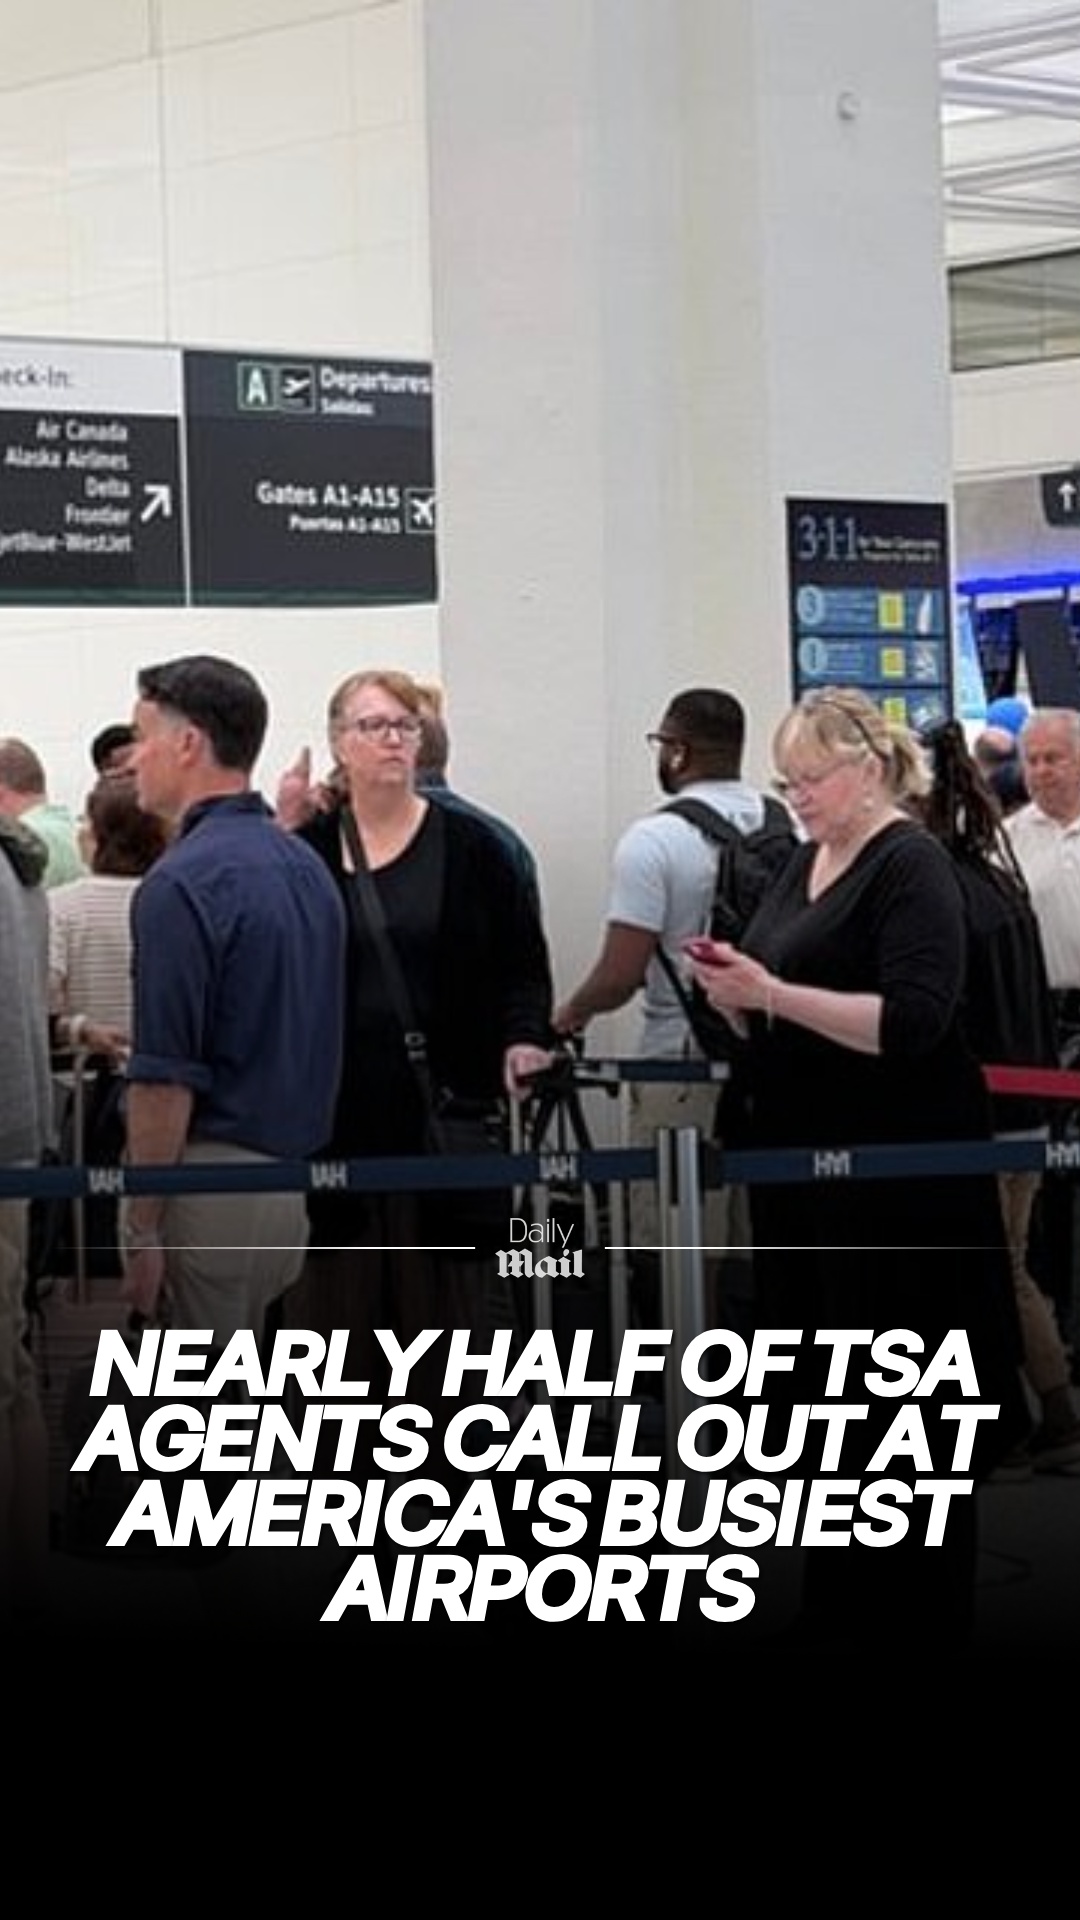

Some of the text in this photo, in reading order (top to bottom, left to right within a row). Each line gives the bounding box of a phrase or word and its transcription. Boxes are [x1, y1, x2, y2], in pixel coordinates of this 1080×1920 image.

[246, 366, 268, 404] A
[320, 365, 433, 394] Departures
[36, 419, 128, 443] Air Canada
[5, 445, 130, 470] Alaska Airlines
[85, 475, 130, 498] Delta
[256, 480, 400, 508] Gates A1-A15
[65, 503, 131, 525] Frontier
[289, 513, 344, 532] Puertas
[310, 1160, 348, 1188] IAH
[539, 1154, 578, 1180] IAH
[88, 1168, 126, 1194] IAH
